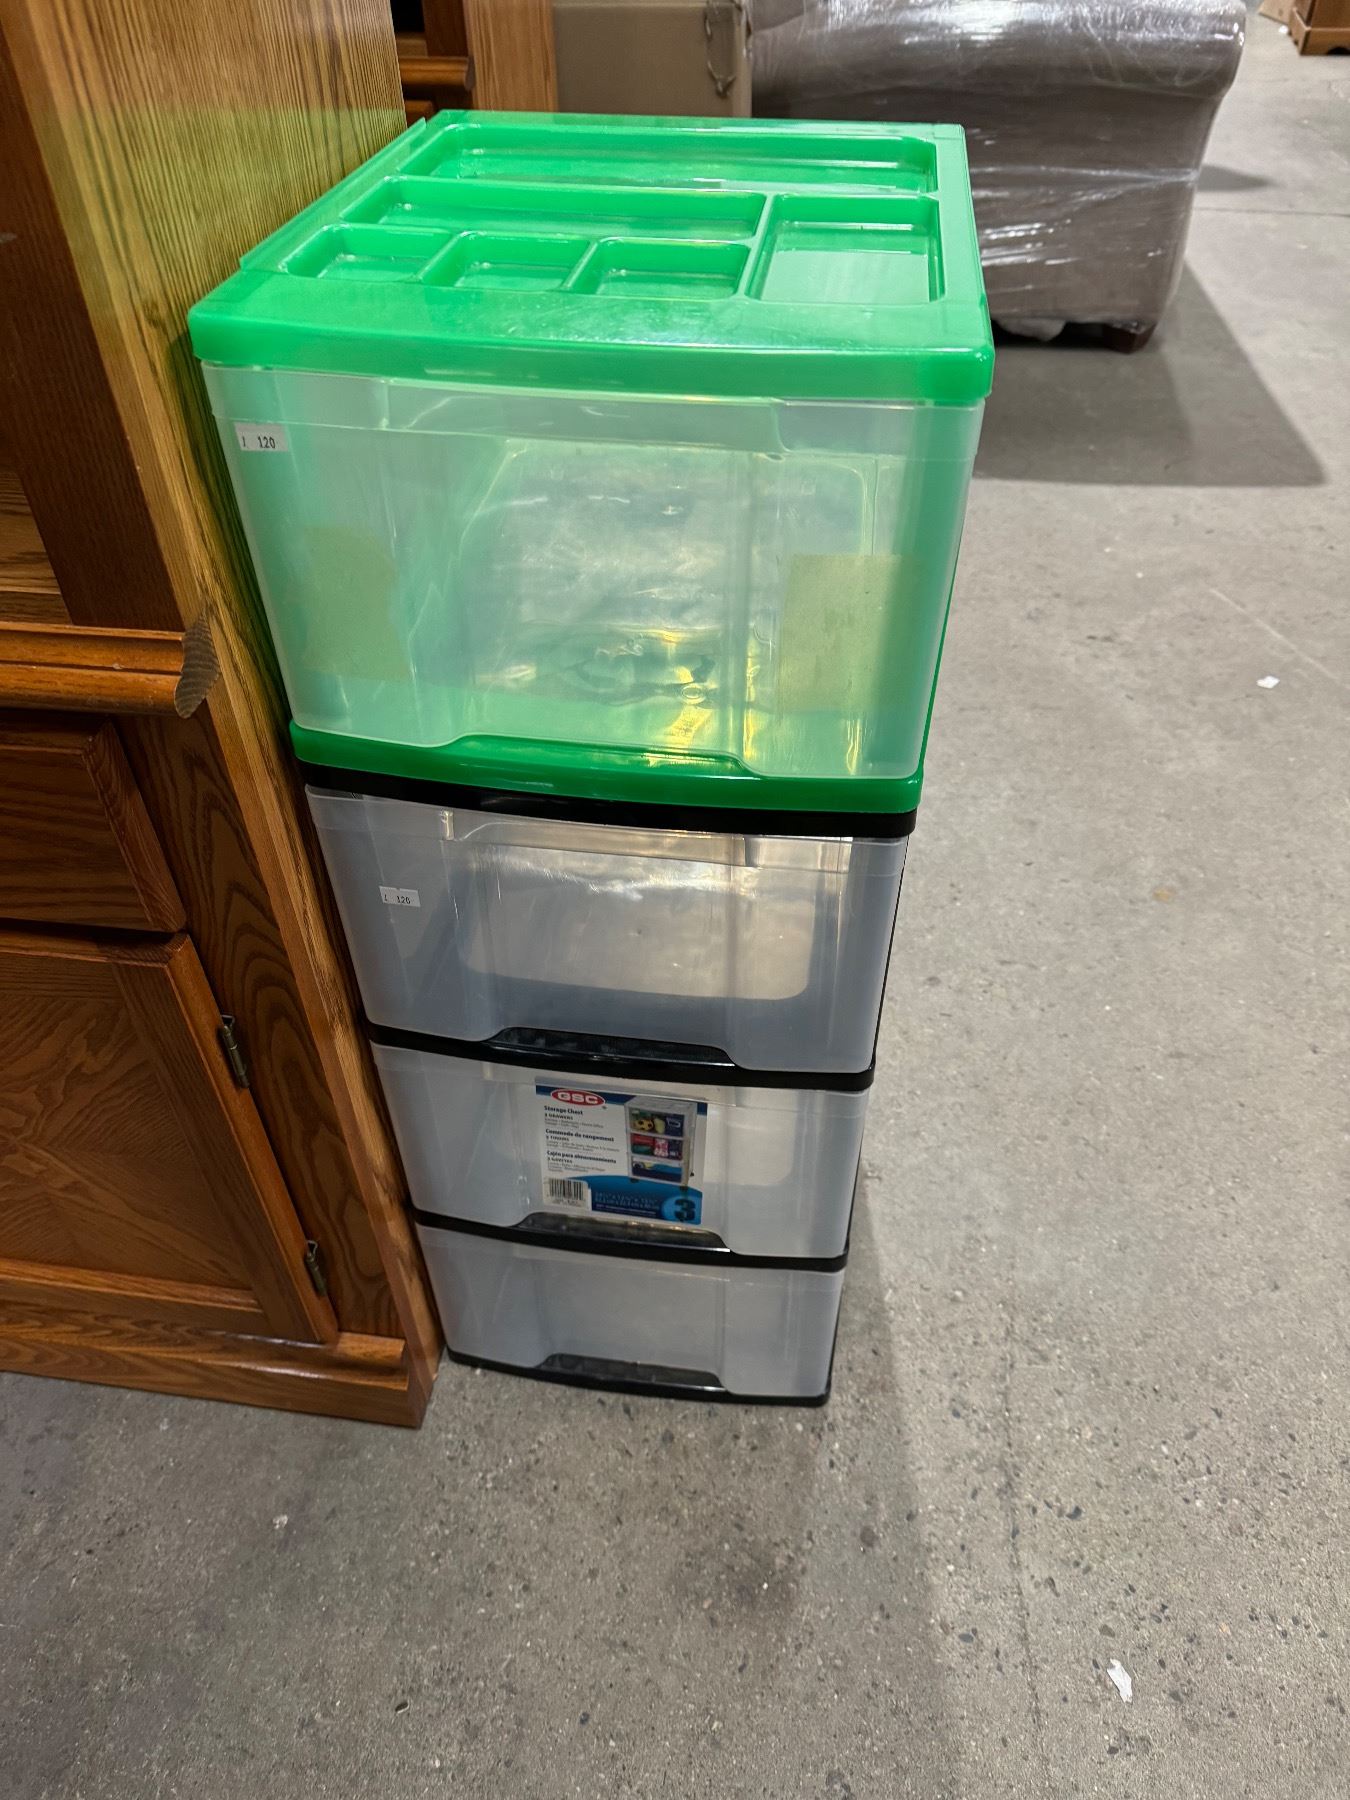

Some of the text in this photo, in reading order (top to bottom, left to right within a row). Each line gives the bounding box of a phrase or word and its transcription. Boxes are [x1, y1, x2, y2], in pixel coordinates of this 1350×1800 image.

[257, 435, 276, 449] 120
[557, 1091, 598, 1105] GSC
[543, 1105, 583, 1116] Storage Chest
[545, 1128, 573, 1137] Commode
[582, 1133, 615, 1142] rangement
[674, 1197, 696, 1222] 3
